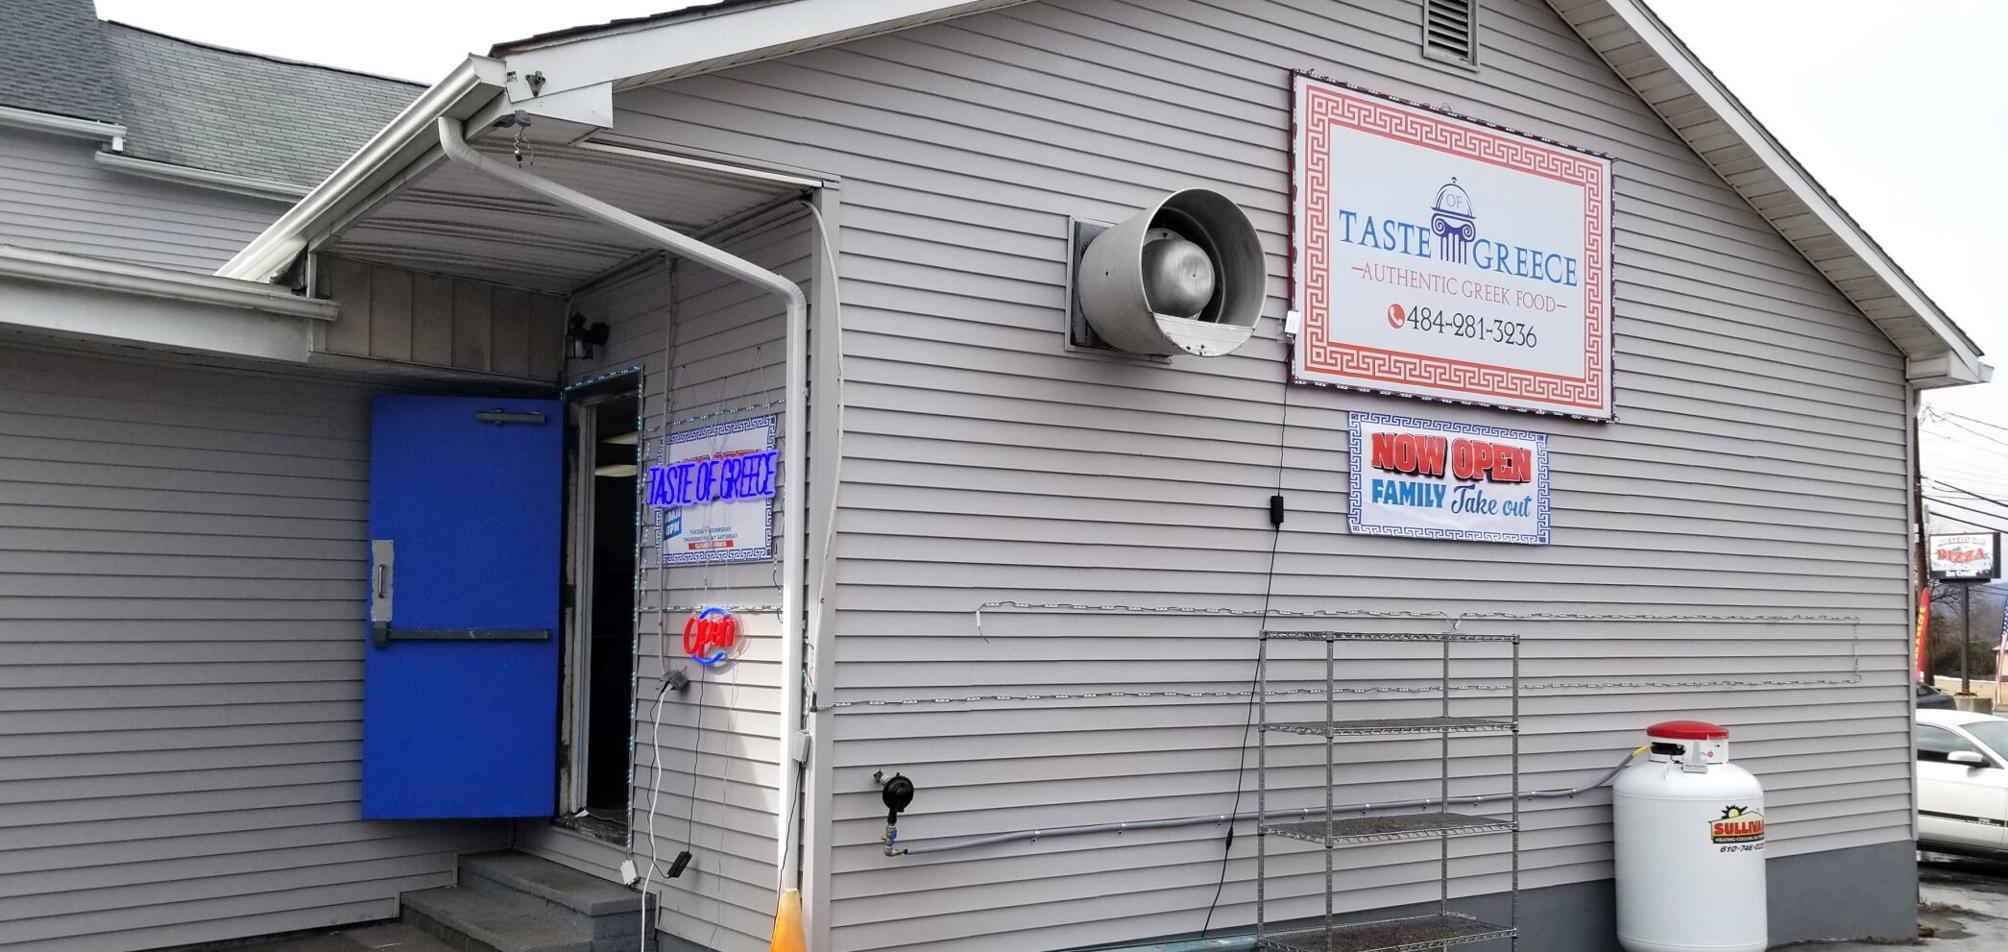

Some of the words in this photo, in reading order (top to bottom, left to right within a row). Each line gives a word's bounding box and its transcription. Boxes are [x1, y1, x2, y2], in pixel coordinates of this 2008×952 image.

[1339, 210, 1432, 258] TASTE
[1446, 193, 1463, 209] OF
[1472, 238, 1578, 287] GREECE
[1461, 280, 1510, 305] GREEK
[1407, 305, 1538, 348] 484-281-3236
[648, 464, 696, 505] TASTE
[696, 460, 720, 501] OF
[720, 452, 778, 498] GREECE
[1371, 432, 1448, 478] NOW
[1451, 437, 1533, 484] OPEN
[1371, 479, 1447, 508] FAMILY
[1451, 484, 1499, 515] Take
[1502, 495, 1533, 517] out
[684, 615, 735, 658] Open
